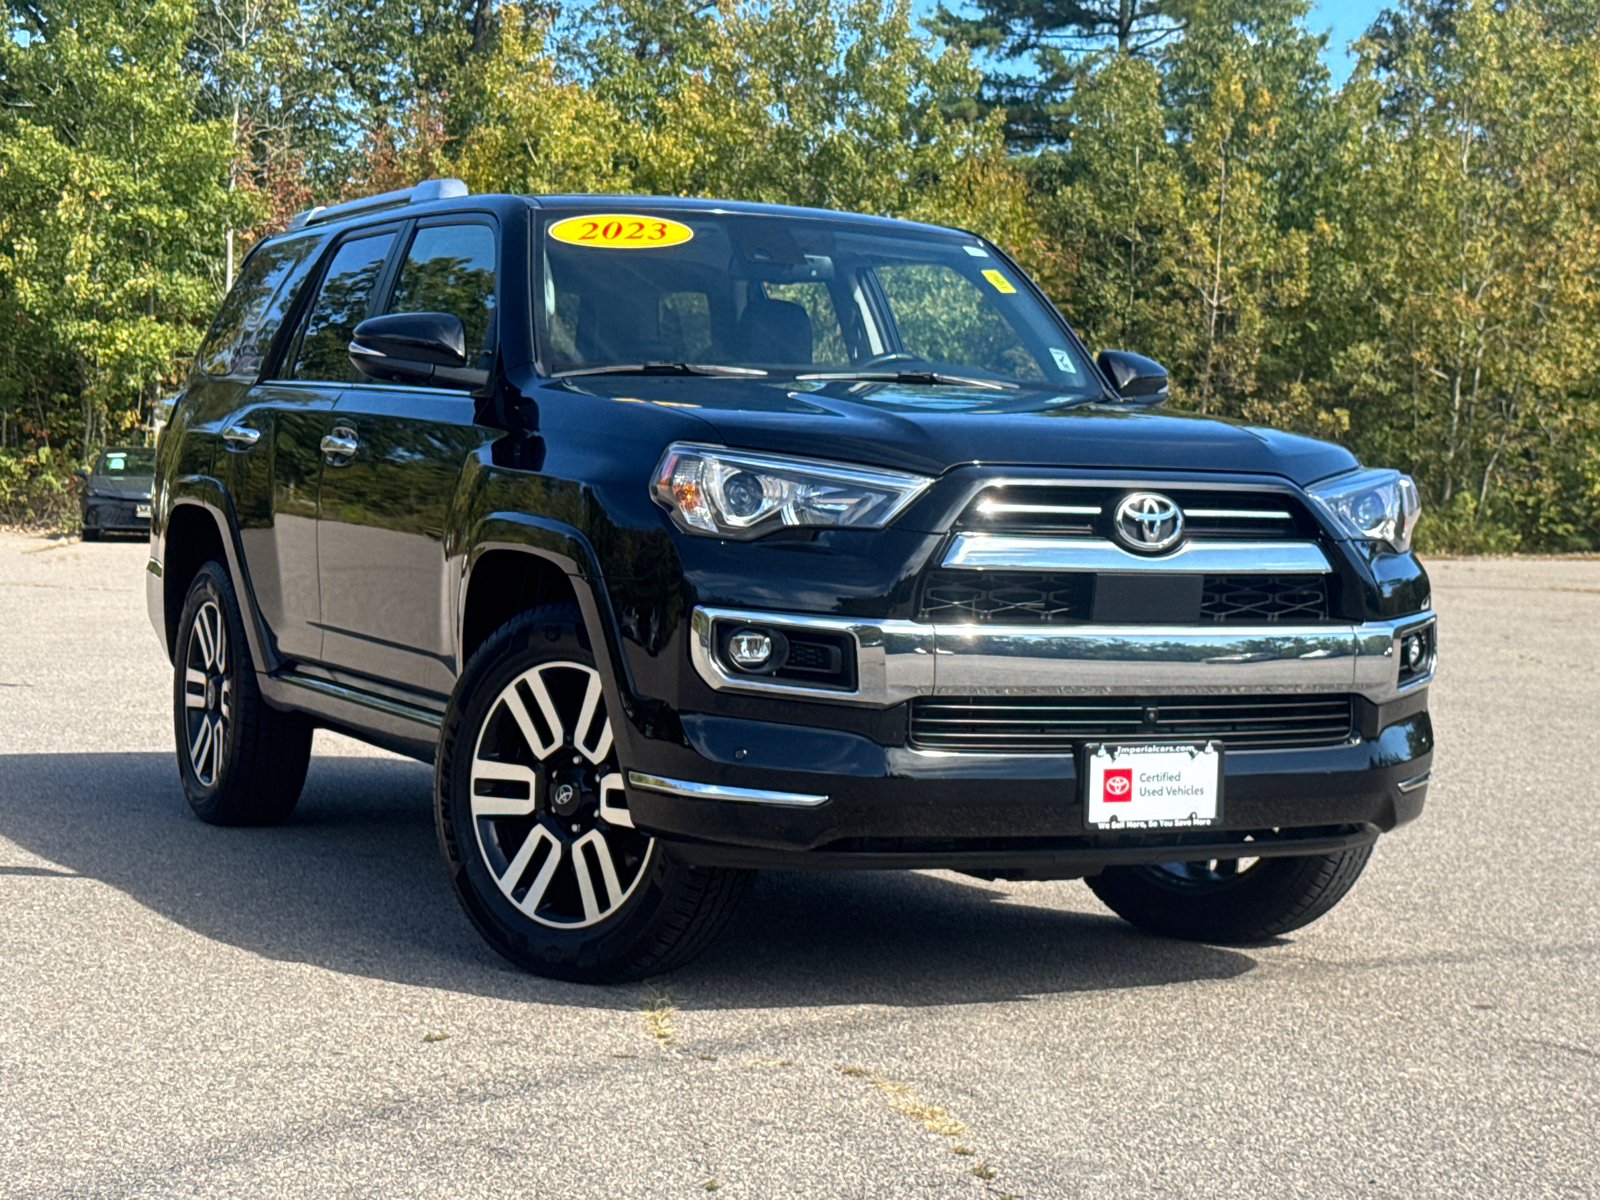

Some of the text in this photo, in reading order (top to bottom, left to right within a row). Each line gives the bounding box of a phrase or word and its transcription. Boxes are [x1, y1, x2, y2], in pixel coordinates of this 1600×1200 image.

[577, 221, 668, 241] 2023
[1139, 771, 1181, 782] Certified
[440, 720, 461, 861] GENERAL
[1139, 785, 1204, 797] Used Vehicles
[1111, 820, 1124, 829] Sell
[1148, 819, 1158, 828] So
[1159, 819, 1173, 828] You
[1174, 818, 1191, 827] Save
[1193, 818, 1211, 826] More
